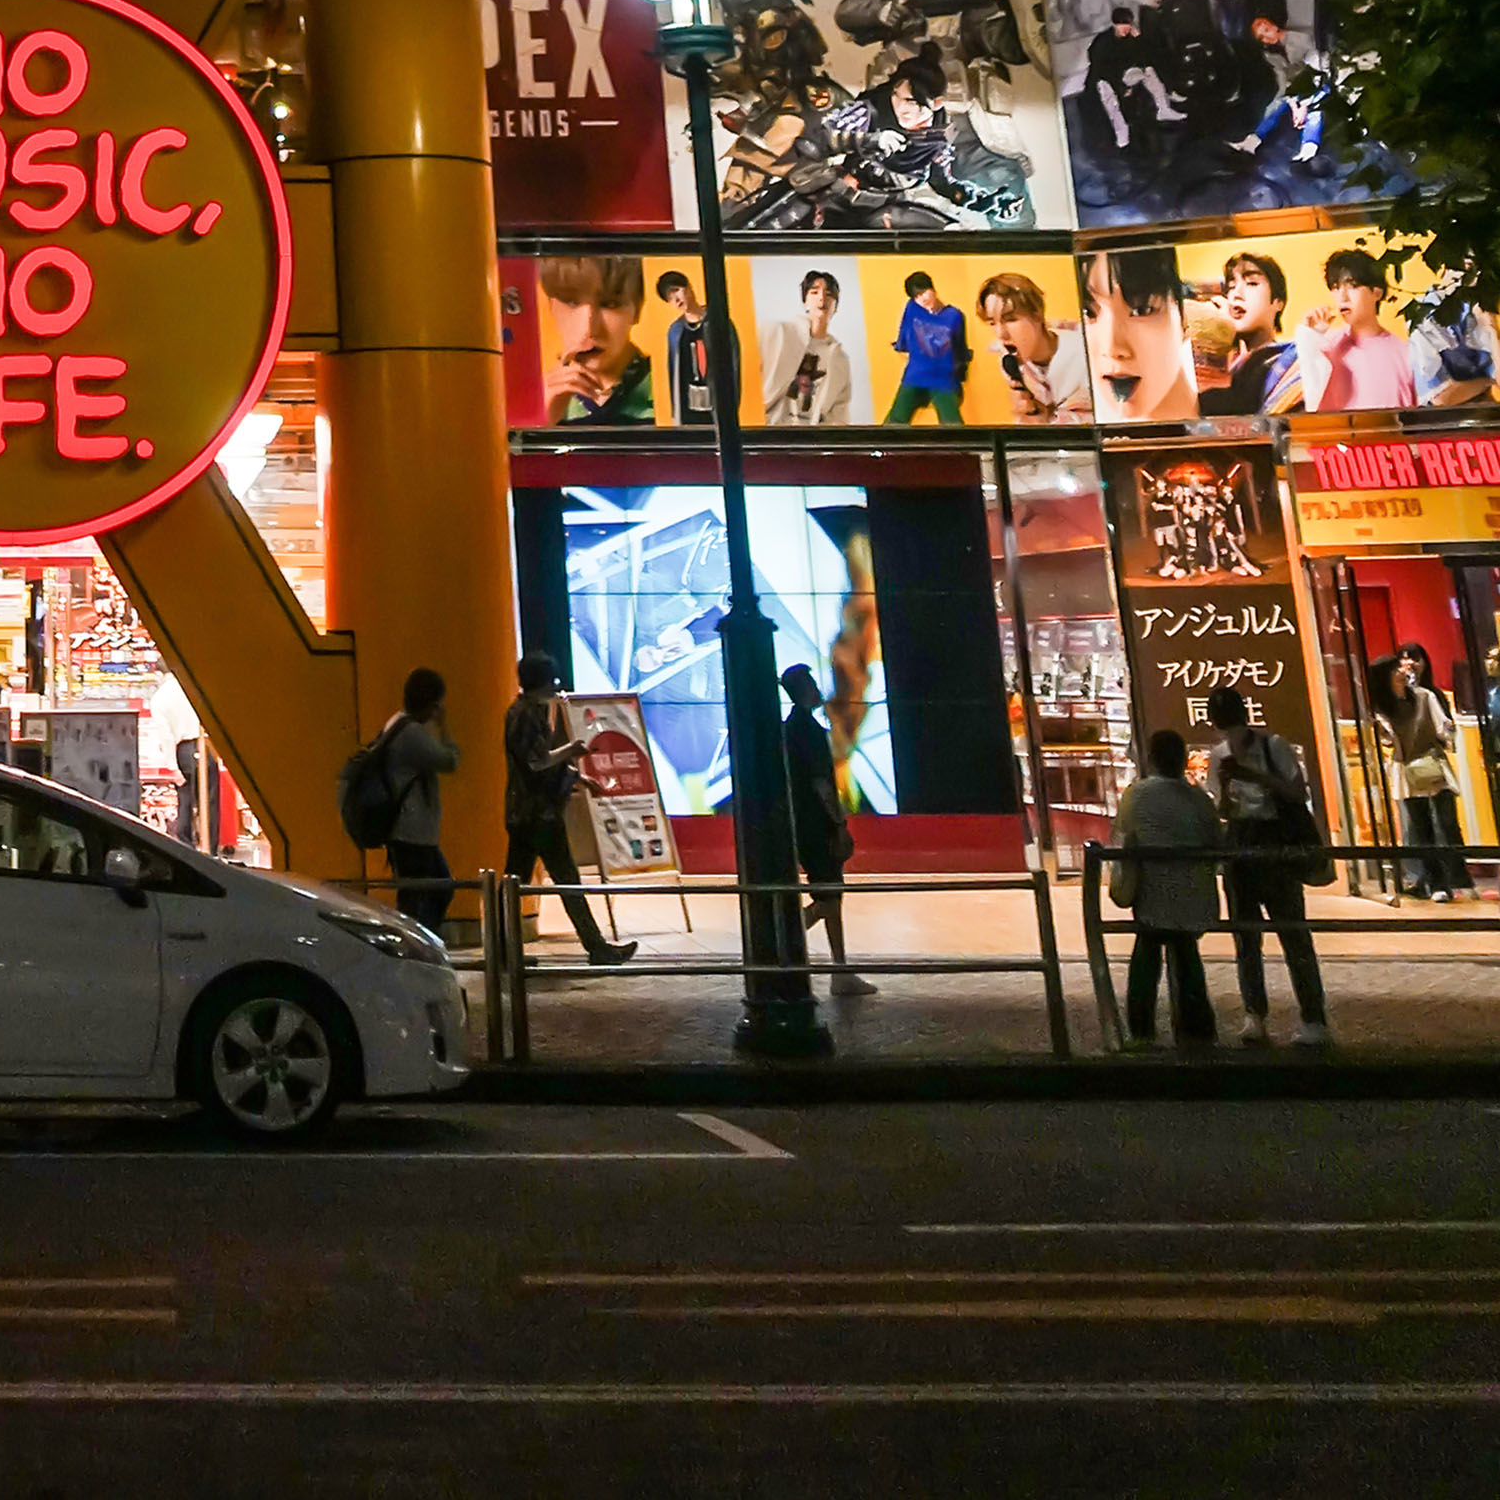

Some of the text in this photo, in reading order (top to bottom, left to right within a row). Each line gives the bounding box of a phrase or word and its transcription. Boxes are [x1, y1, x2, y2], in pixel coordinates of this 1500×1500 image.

[1308, 437, 1500, 491] TOWER RECO
[1134, 602, 1297, 640] アンジュルム
[1156, 658, 1285, 689] アイノケダモノ
[1186, 696, 1268, 727] 同生
